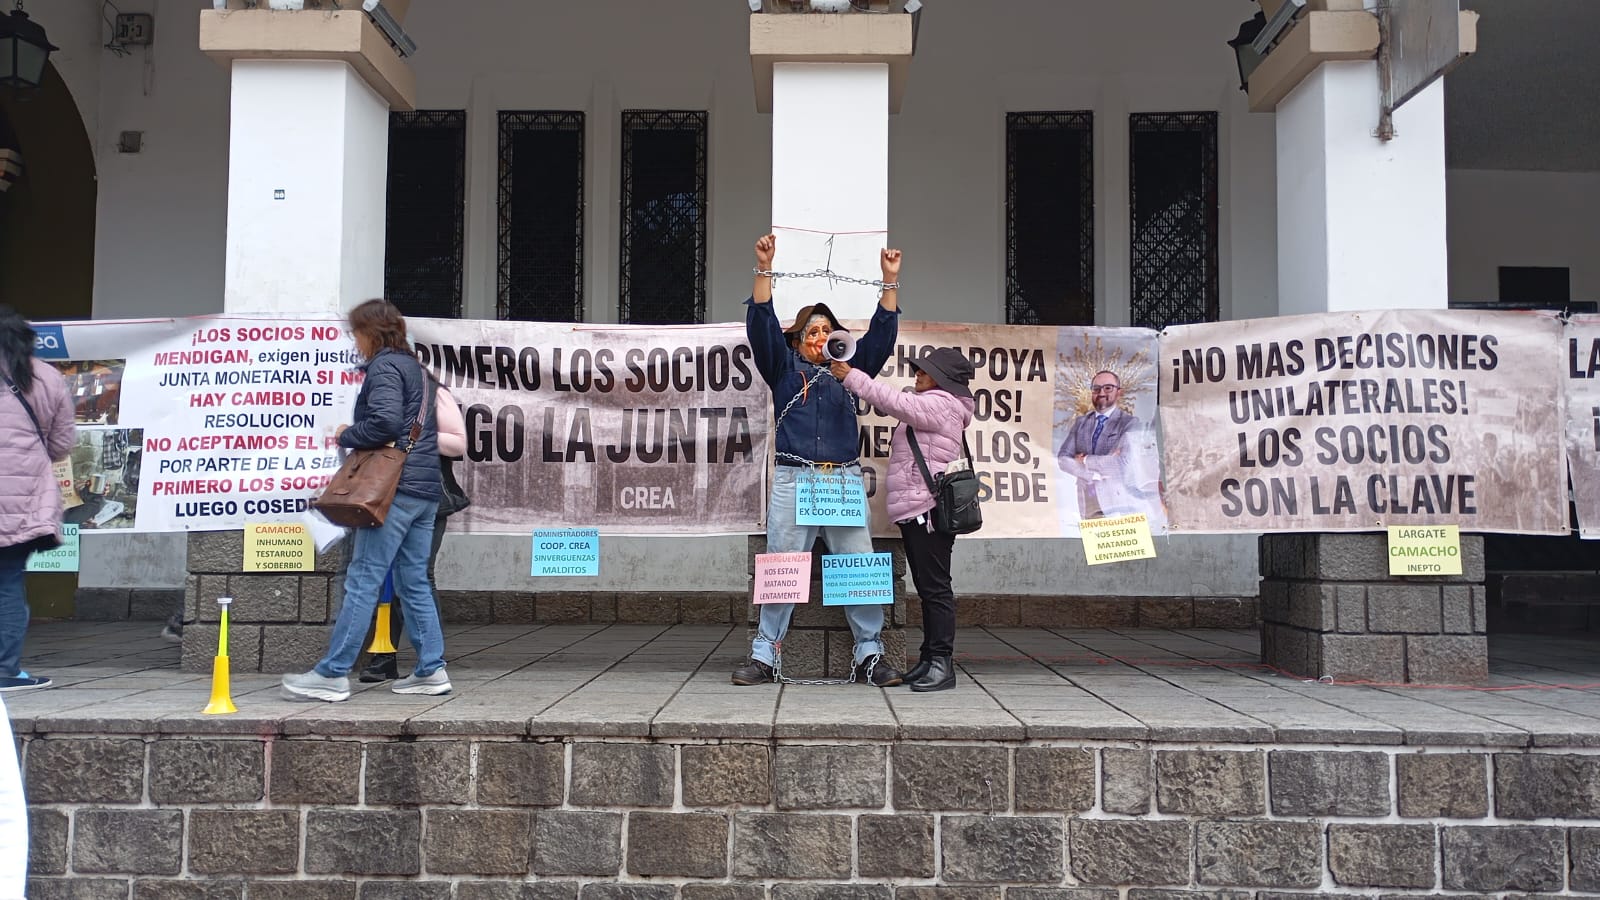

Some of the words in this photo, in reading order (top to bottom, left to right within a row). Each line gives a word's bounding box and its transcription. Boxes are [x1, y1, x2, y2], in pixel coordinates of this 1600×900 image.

[192, 328, 231, 347] ¡LOS
[236, 327, 305, 342] SOCIOS
[154, 349, 254, 366] MENDIGAN,
[258, 348, 310, 366] exigen
[953, 346, 1047, 382] POYA
[1172, 346, 1226, 392] ¡NO
[1235, 339, 1305, 381] MAS
[1314, 333, 1498, 372] DECISIONES
[552, 347, 615, 393] LOS
[625, 344, 753, 393] SOCIOS
[160, 372, 210, 387] JUNTA
[215, 370, 312, 385] MONETARIA
[317, 370, 334, 385] SI
[190, 393, 226, 408] HAY
[231, 392, 306, 407] CAMBIO
[311, 392, 333, 407] DE
[1229, 377, 1468, 425] UNILATERALES!
[204, 413, 315, 429] RESOLUCION
[146, 438, 172, 452] NO
[177, 435, 288, 451] ACEPTAMOS
[295, 435, 318, 450] EL
[542, 407, 596, 463] LA
[607, 407, 754, 464] JUNTA
[1238, 427, 1301, 468] LOS
[1314, 424, 1451, 465] SOCIOS
[160, 459, 192, 473] POR
[196, 457, 251, 472] PARTE
[257, 457, 280, 471] DE
[284, 456, 306, 470] LA
[152, 479, 232, 496] PRIMERO
[239, 477, 274, 493] LOS
[620, 487, 676, 509] CREA
[1220, 476, 1298, 517] SON
[1310, 475, 1356, 516] LA
[1367, 473, 1477, 515] CLAVE
[175, 500, 237, 517] LUEGO
[799, 508, 810, 516] EX
[841, 508, 862, 517] CREA
[255, 526, 304, 534] CAMACHO:
[1112, 528, 1137, 537] ESTAN
[1398, 529, 1446, 538] LARGATE
[540, 542, 567, 550] COOP.
[568, 542, 590, 550] CREA
[1097, 539, 1138, 549] MATANDO
[1390, 545, 1458, 557] CAMACHO
[255, 550, 303, 558] TESTARUDO
[1094, 549, 1146, 561] LENTAMENTE
[542, 566, 587, 574] MALDITOS
[823, 557, 890, 568] DEVUELVAN
[1407, 564, 1441, 572] INEPTO
[760, 592, 801, 600] LENTAMENTE
[848, 589, 892, 598] PRESENTES
